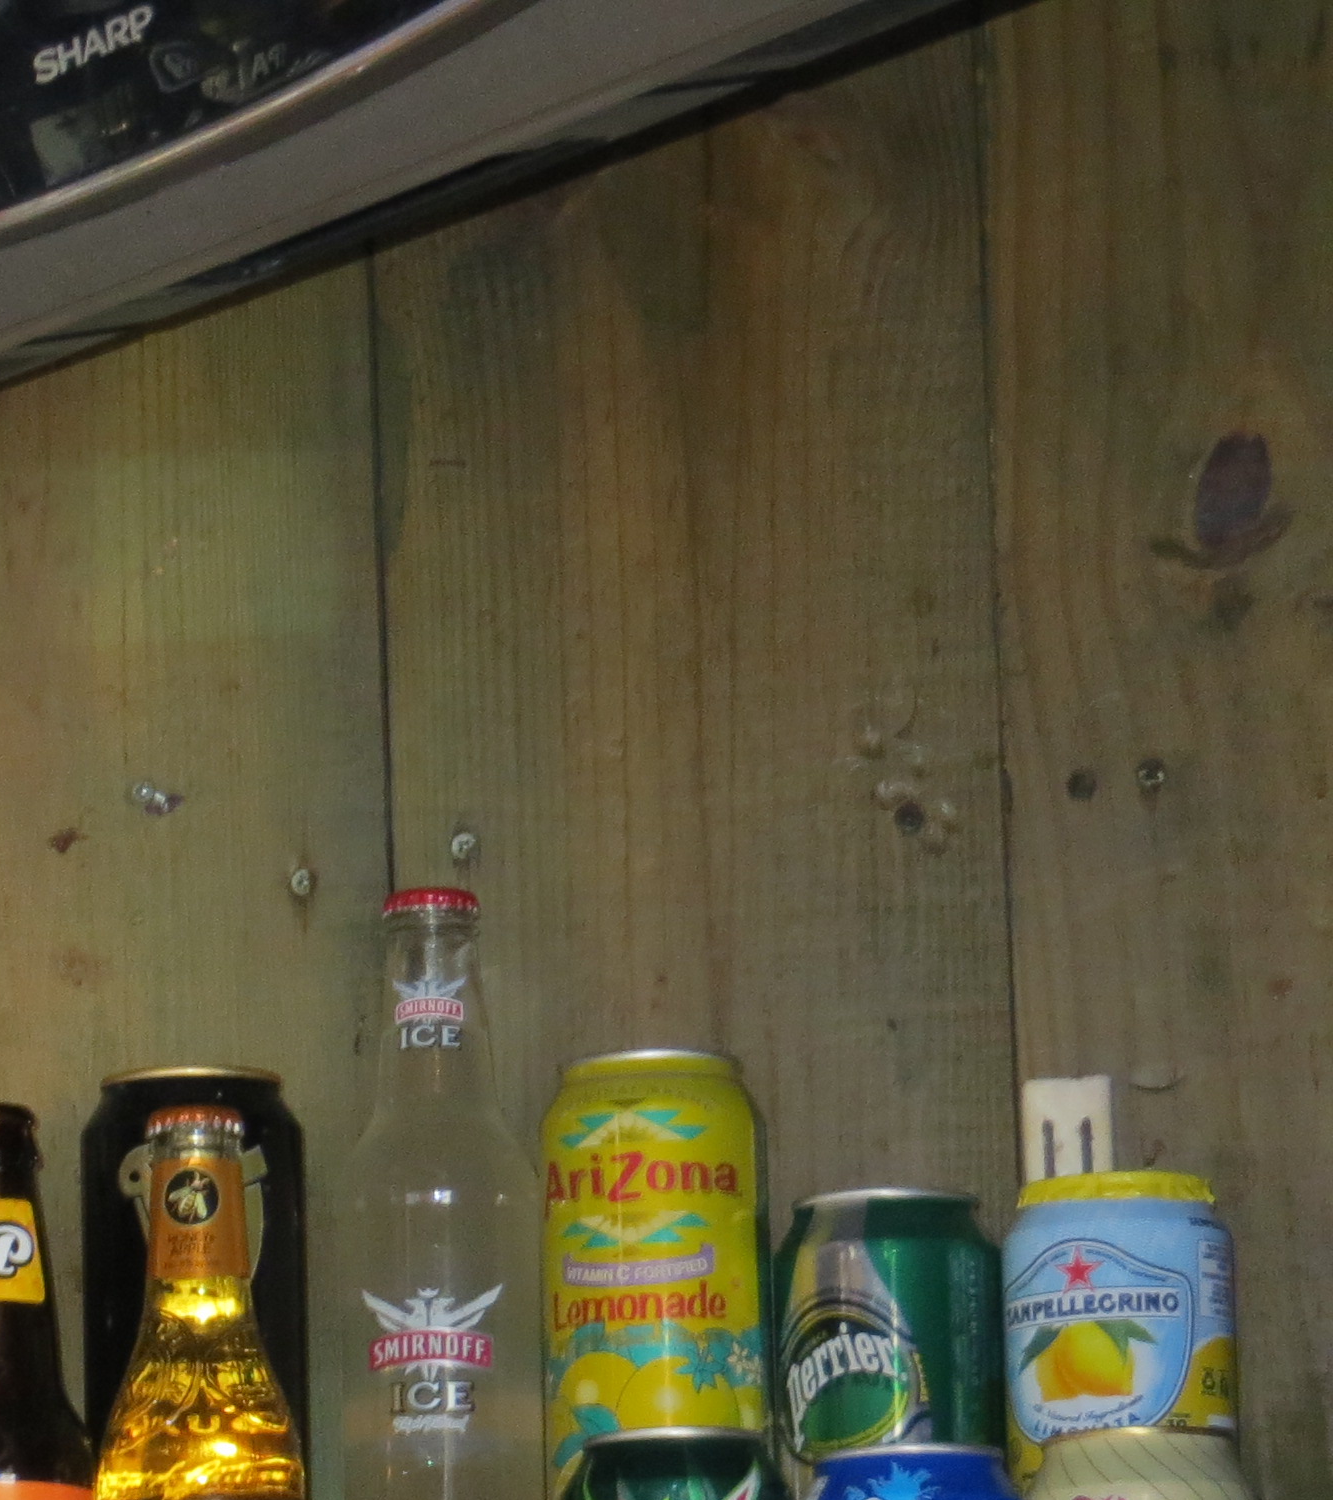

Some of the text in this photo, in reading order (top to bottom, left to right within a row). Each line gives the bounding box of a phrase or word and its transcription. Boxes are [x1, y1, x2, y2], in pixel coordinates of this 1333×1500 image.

[33, 4, 156, 86] SHARP
[396, 999, 462, 1020] SMIRNOFF
[399, 1025, 462, 1050] ICE
[544, 1150, 739, 1220] AriZona
[552, 1280, 727, 1332] Lemonade
[372, 1333, 488, 1368] SMIRNOFF
[391, 1380, 476, 1414] ICE
[786, 1321, 897, 1455] perrier
